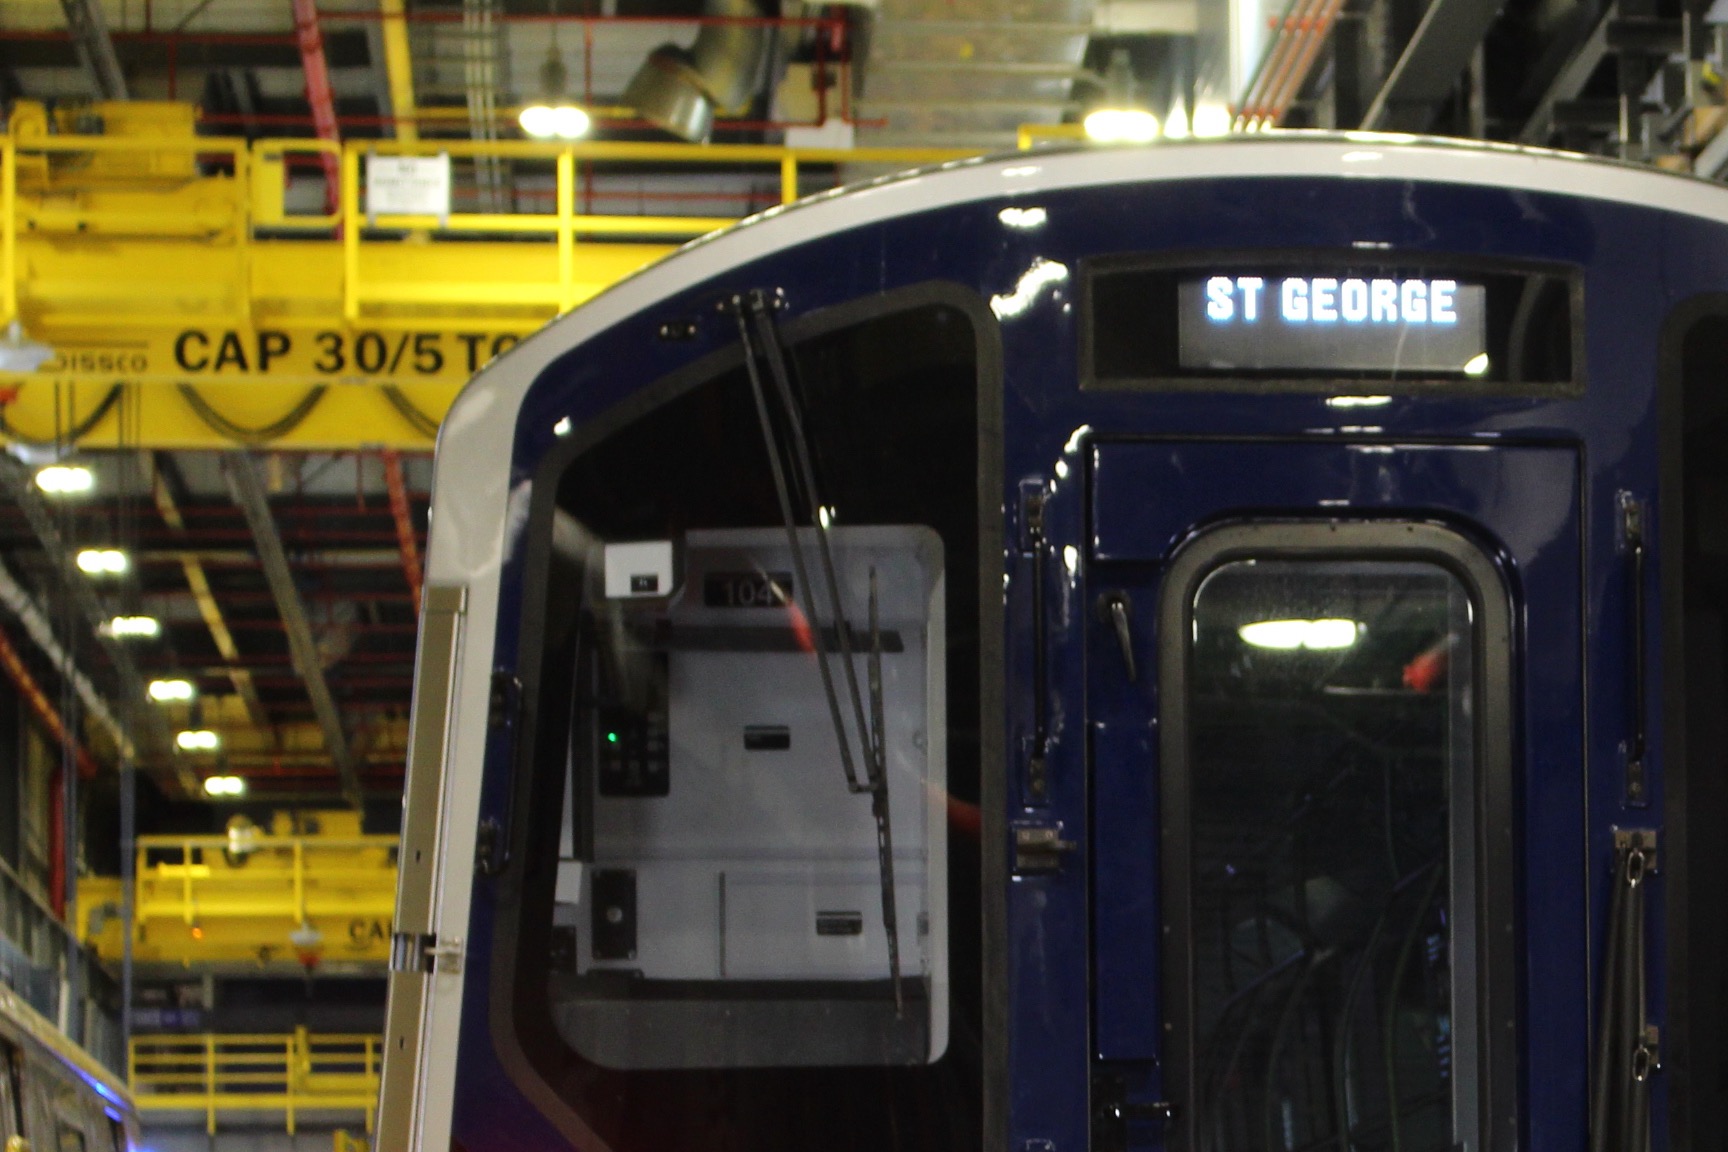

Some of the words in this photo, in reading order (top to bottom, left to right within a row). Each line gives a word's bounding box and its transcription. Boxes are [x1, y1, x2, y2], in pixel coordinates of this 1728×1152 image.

[1206, 276, 1264, 322] ST
[1281, 277, 1458, 324] GEORGE
[174, 329, 291, 373] CAP
[315, 331, 444, 375] 30/5
[349, 918, 392, 942] CA
